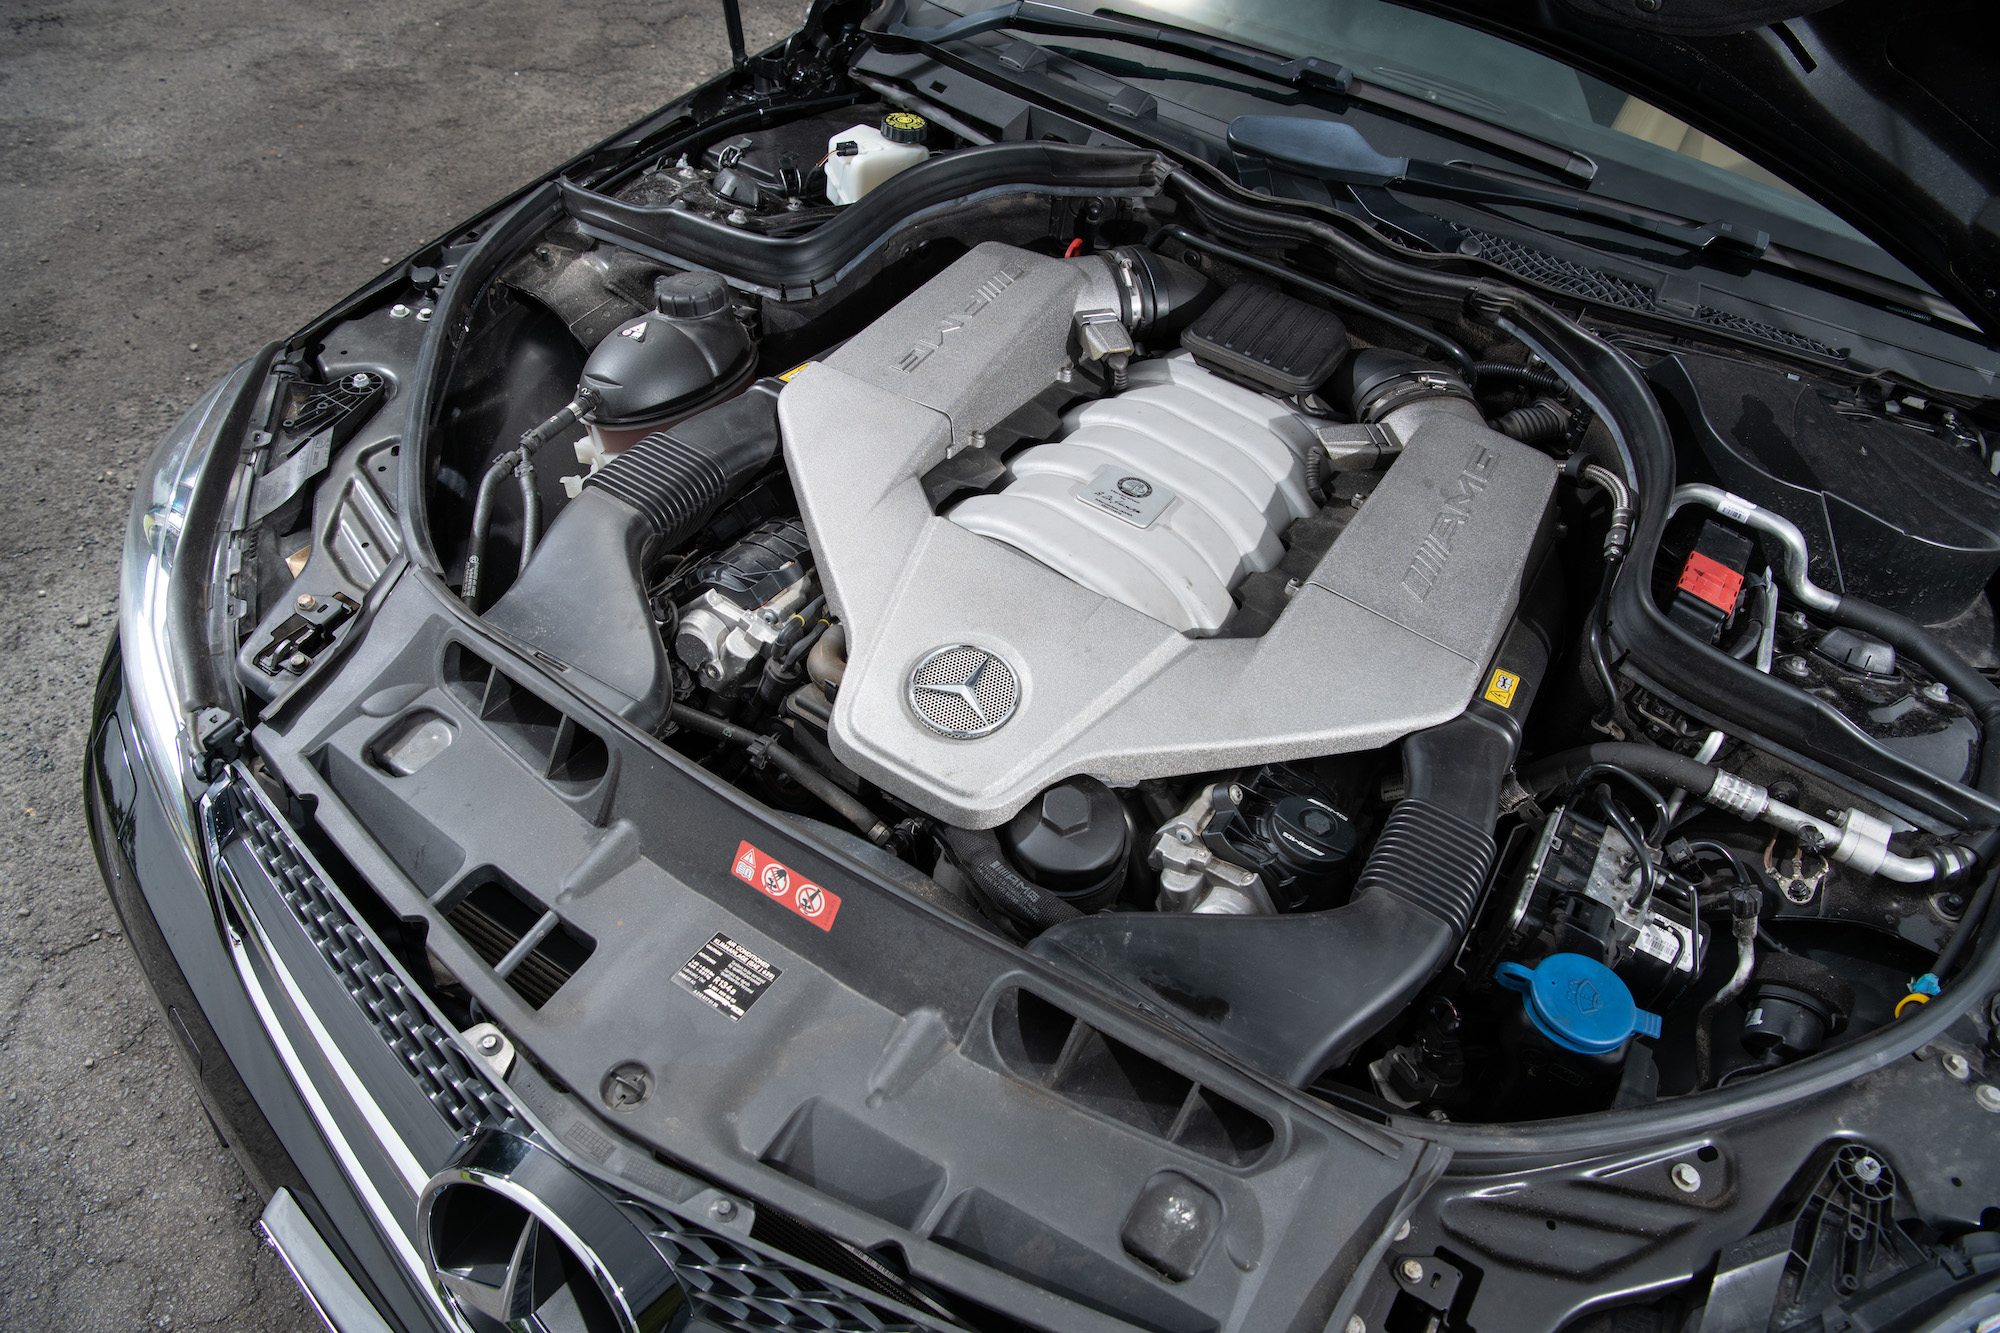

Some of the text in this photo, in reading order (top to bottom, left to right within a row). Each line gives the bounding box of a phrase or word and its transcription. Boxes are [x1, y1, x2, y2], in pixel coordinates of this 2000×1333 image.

[712, 938, 749, 963] KLIMAANLAGE
[726, 939, 737, 948] AIR
[734, 944, 770, 969] CONDITIONER
[711, 975, 738, 995] R134a
